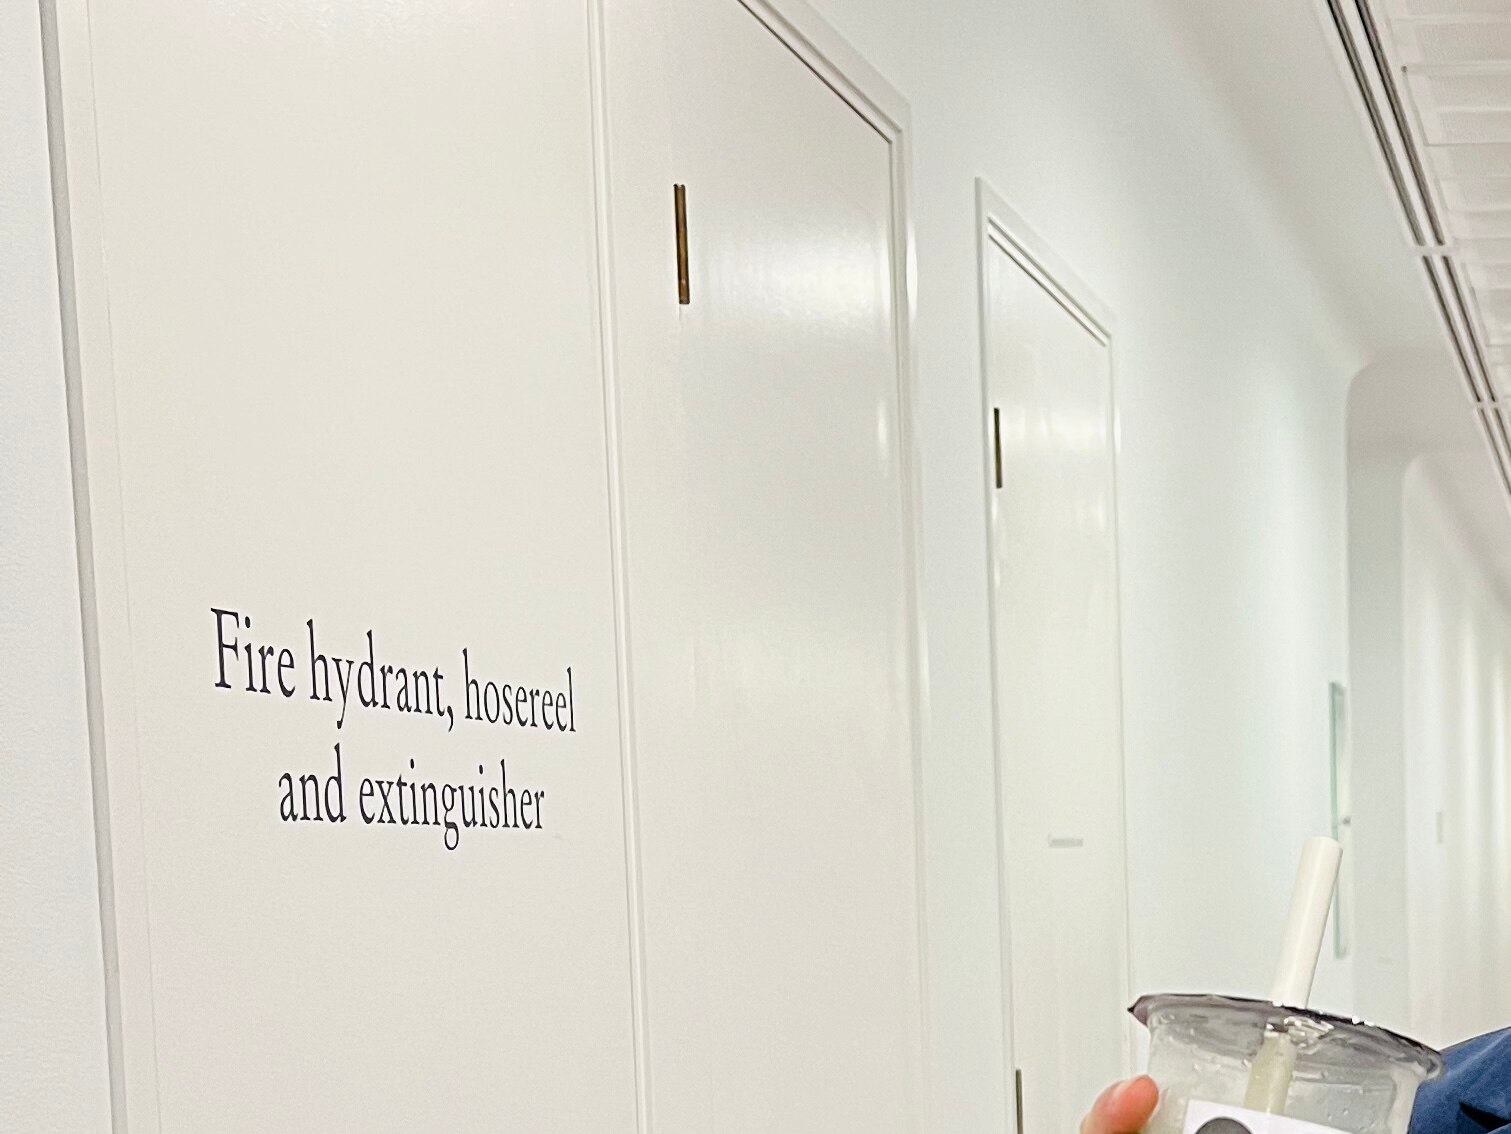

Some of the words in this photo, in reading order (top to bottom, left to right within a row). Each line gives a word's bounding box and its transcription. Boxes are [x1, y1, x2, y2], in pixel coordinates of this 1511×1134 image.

[210, 607, 296, 698] Fire
[306, 618, 454, 733] hydrant,
[462, 647, 577, 733] hosereel
[278, 742, 347, 823] and
[359, 758, 545, 851] extinguisher
